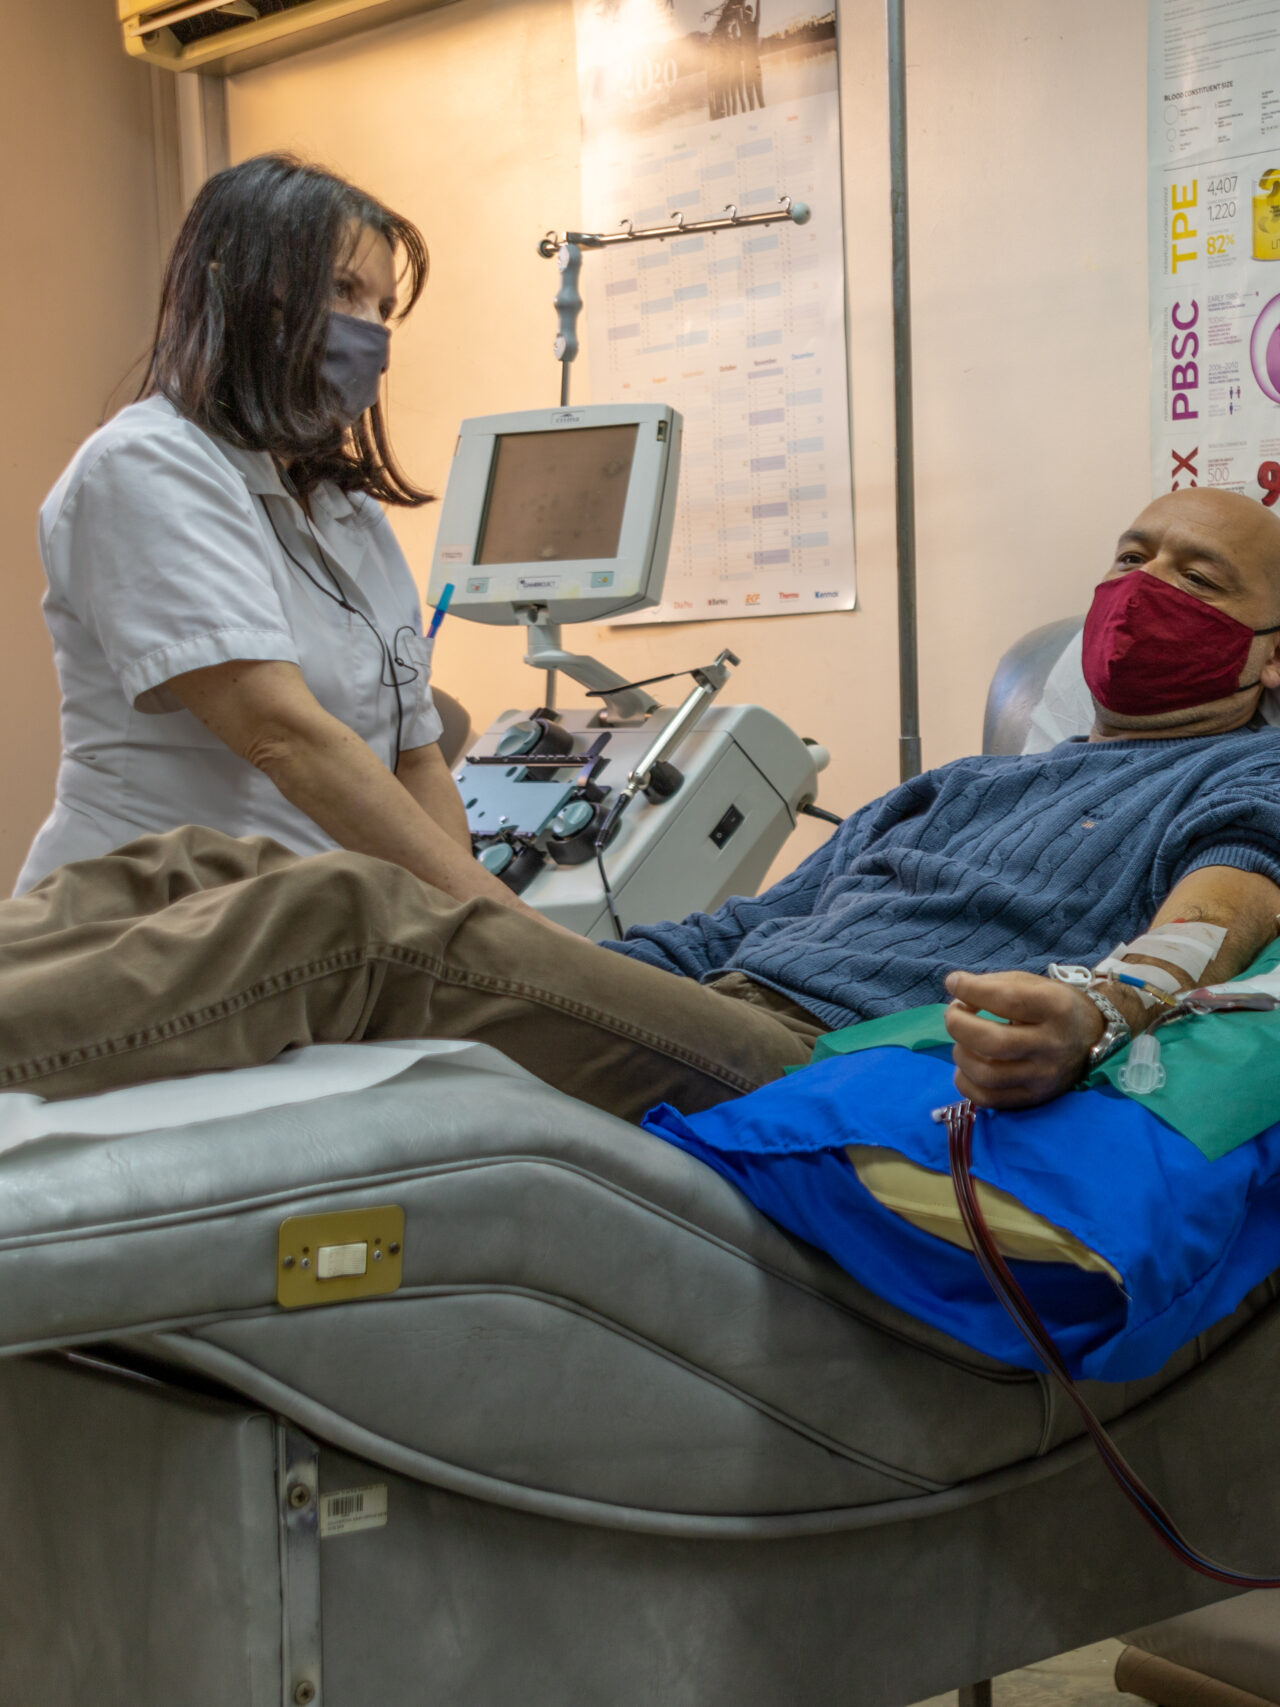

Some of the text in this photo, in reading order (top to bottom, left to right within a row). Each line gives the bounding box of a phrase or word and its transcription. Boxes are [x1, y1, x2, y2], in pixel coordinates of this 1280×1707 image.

[1164, 92, 1184, 102] BLOOD
[1221, 81, 1233, 89] SIZE
[1207, 176, 1238, 196] 4,407
[1207, 201, 1236, 222] 1,220
[1171, 178, 1198, 274] TPE
[1206, 233, 1235, 255] 82%
[1171, 299, 1199, 420] PBSC
[1207, 467, 1230, 483] 500
